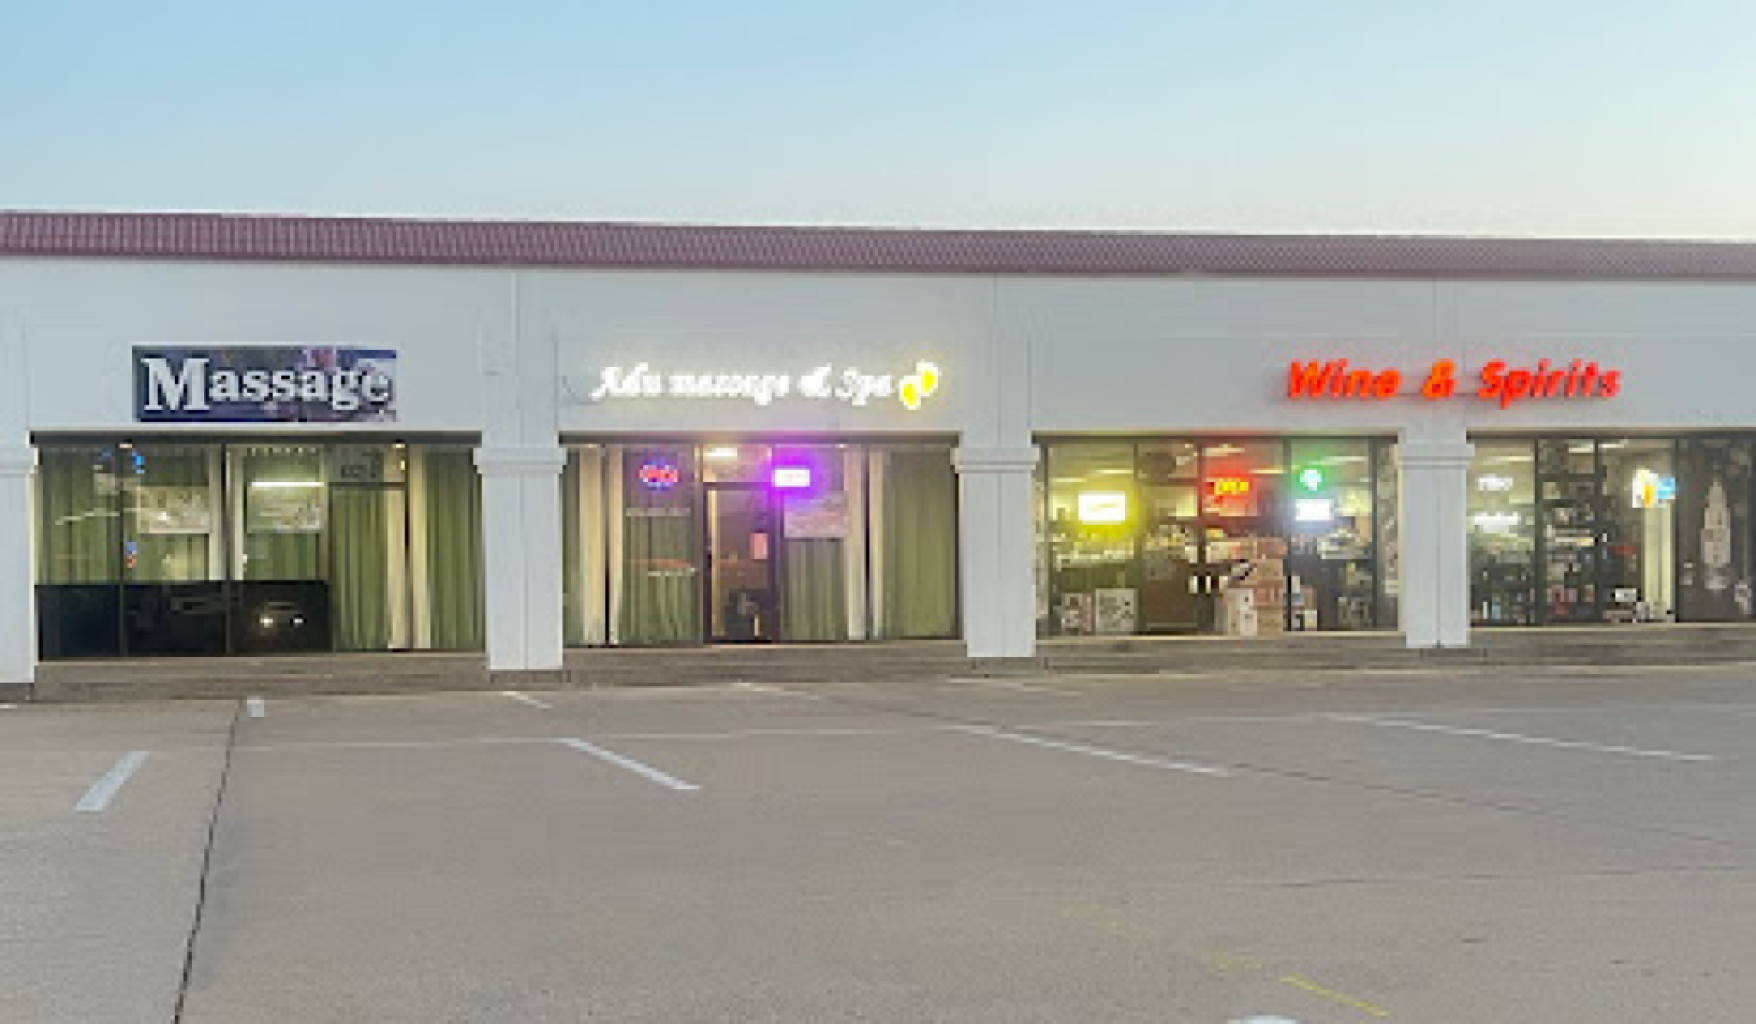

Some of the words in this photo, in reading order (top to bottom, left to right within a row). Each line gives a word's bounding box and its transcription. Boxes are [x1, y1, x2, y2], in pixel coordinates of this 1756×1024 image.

[140, 357, 393, 411] Massage
[799, 362, 832, 398] &
[835, 368, 893, 406] Spa
[1287, 359, 1401, 399] Wine
[1422, 359, 1457, 400] &
[1477, 359, 1621, 409] Spirits
